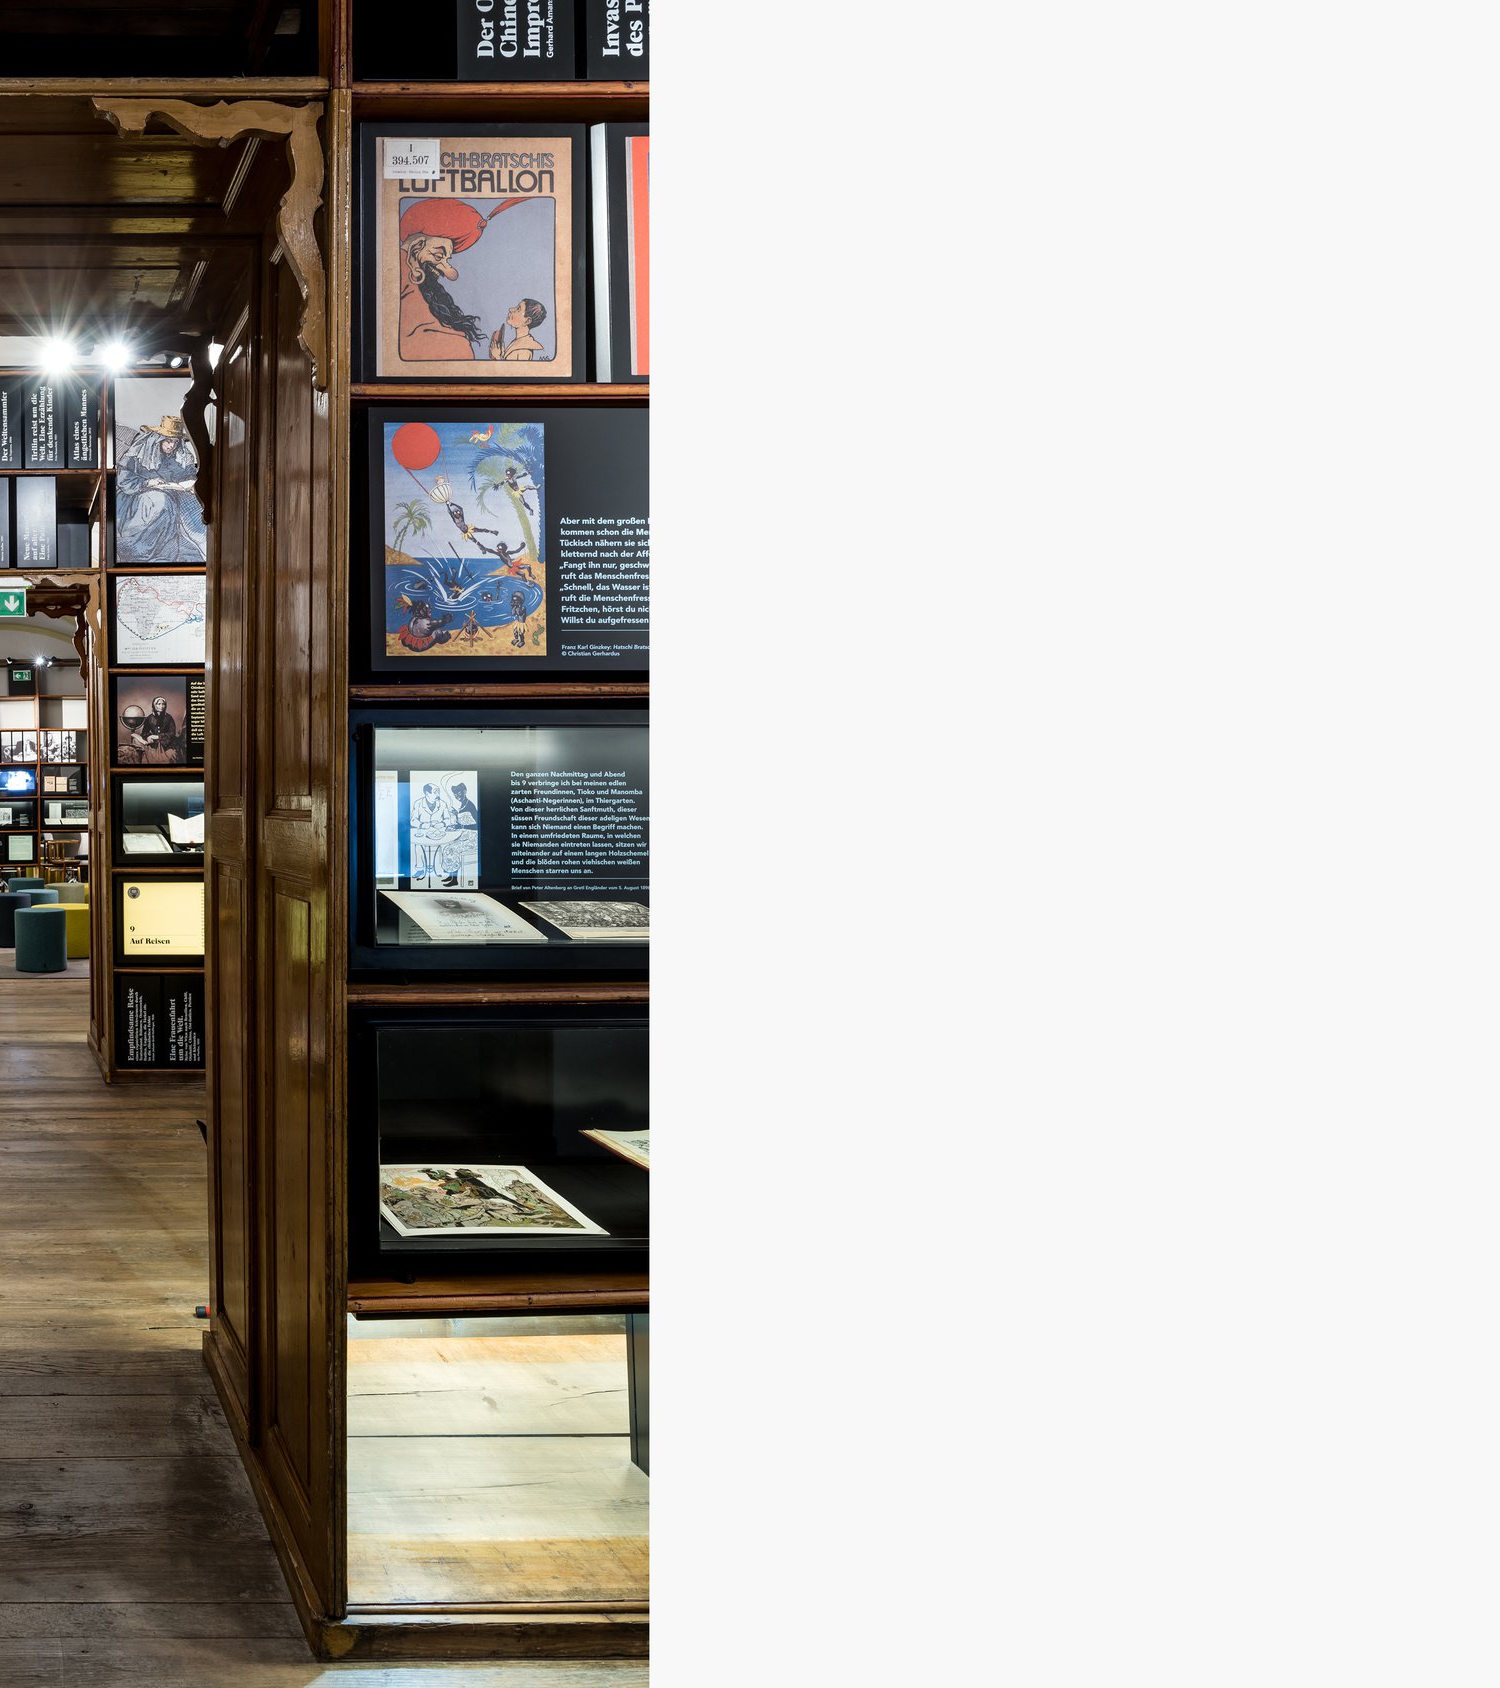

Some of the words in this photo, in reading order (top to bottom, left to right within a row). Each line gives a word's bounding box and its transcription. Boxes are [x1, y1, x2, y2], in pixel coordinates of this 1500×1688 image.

[477, 18, 494, 58] Der
[546, 26, 554, 58] Gerhard
[626, 20, 643, 56] des
[392, 156, 429, 165] 394.507
[46, 387, 54, 412] Kinder
[80, 389, 88, 417] Mannes
[617, 517, 645, 526] großen
[526, 770, 549, 778] ganzen
[528, 779, 559, 787] verbringe
[127, 988, 136, 1008] Reise
[128, 1010, 136, 1060] Empfindsame
[179, 1049, 184, 1061] um
